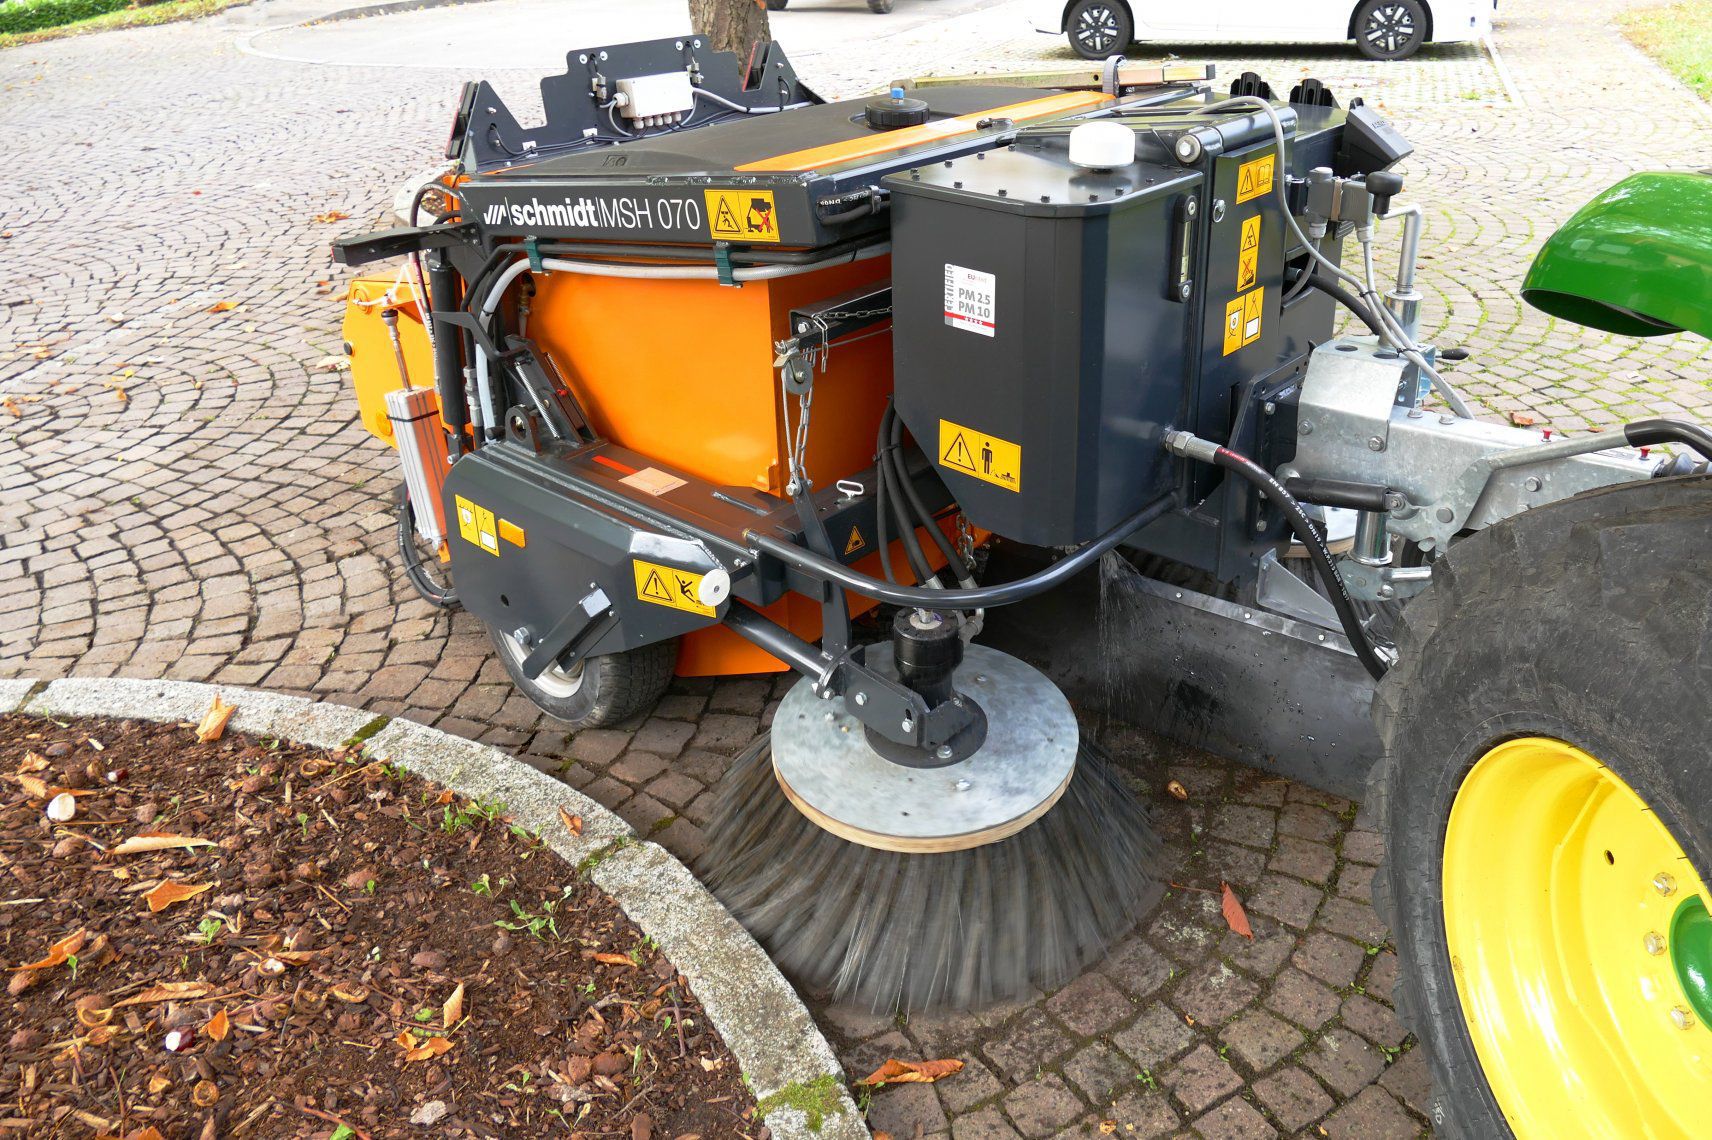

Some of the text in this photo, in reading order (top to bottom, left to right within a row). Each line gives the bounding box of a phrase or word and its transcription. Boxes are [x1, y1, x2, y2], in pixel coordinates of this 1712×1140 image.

[510, 197, 701, 230] schmidt MSH 070
[958, 287, 991, 306] PM 2.5
[958, 300, 991, 319] PM 10
